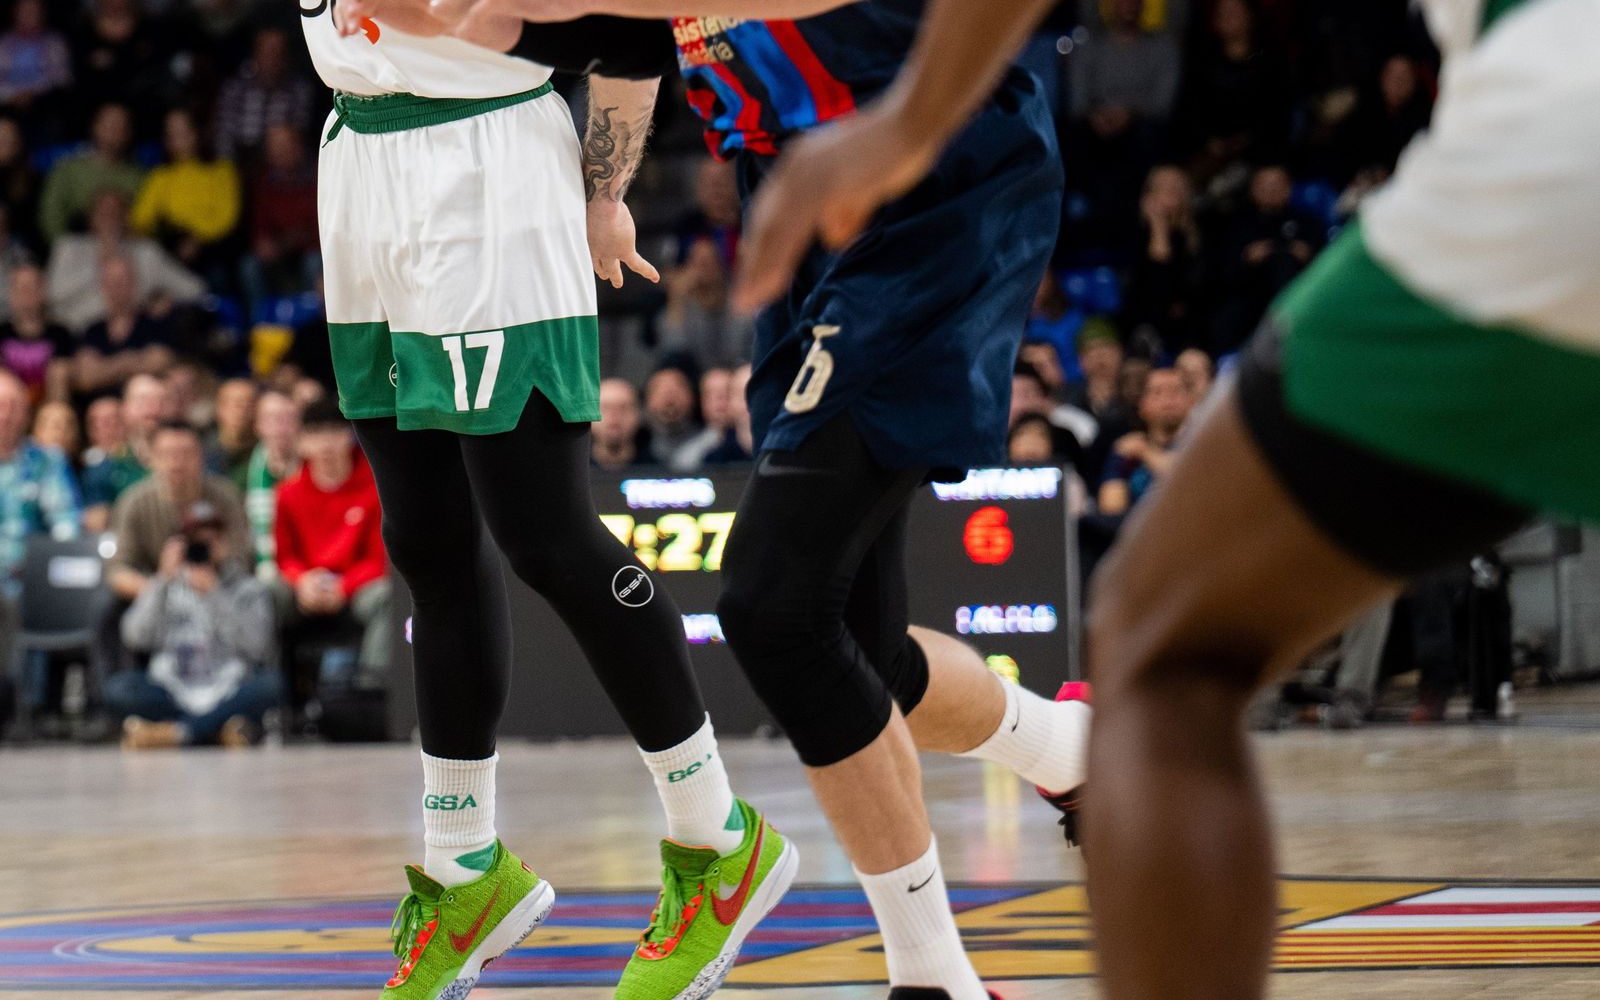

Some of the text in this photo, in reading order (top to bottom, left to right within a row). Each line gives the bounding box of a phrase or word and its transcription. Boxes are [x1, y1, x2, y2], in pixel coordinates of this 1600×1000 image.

[441, 330, 505, 411] 17
[963, 506, 1015, 566] 6
[424, 793, 477, 811] GSA
